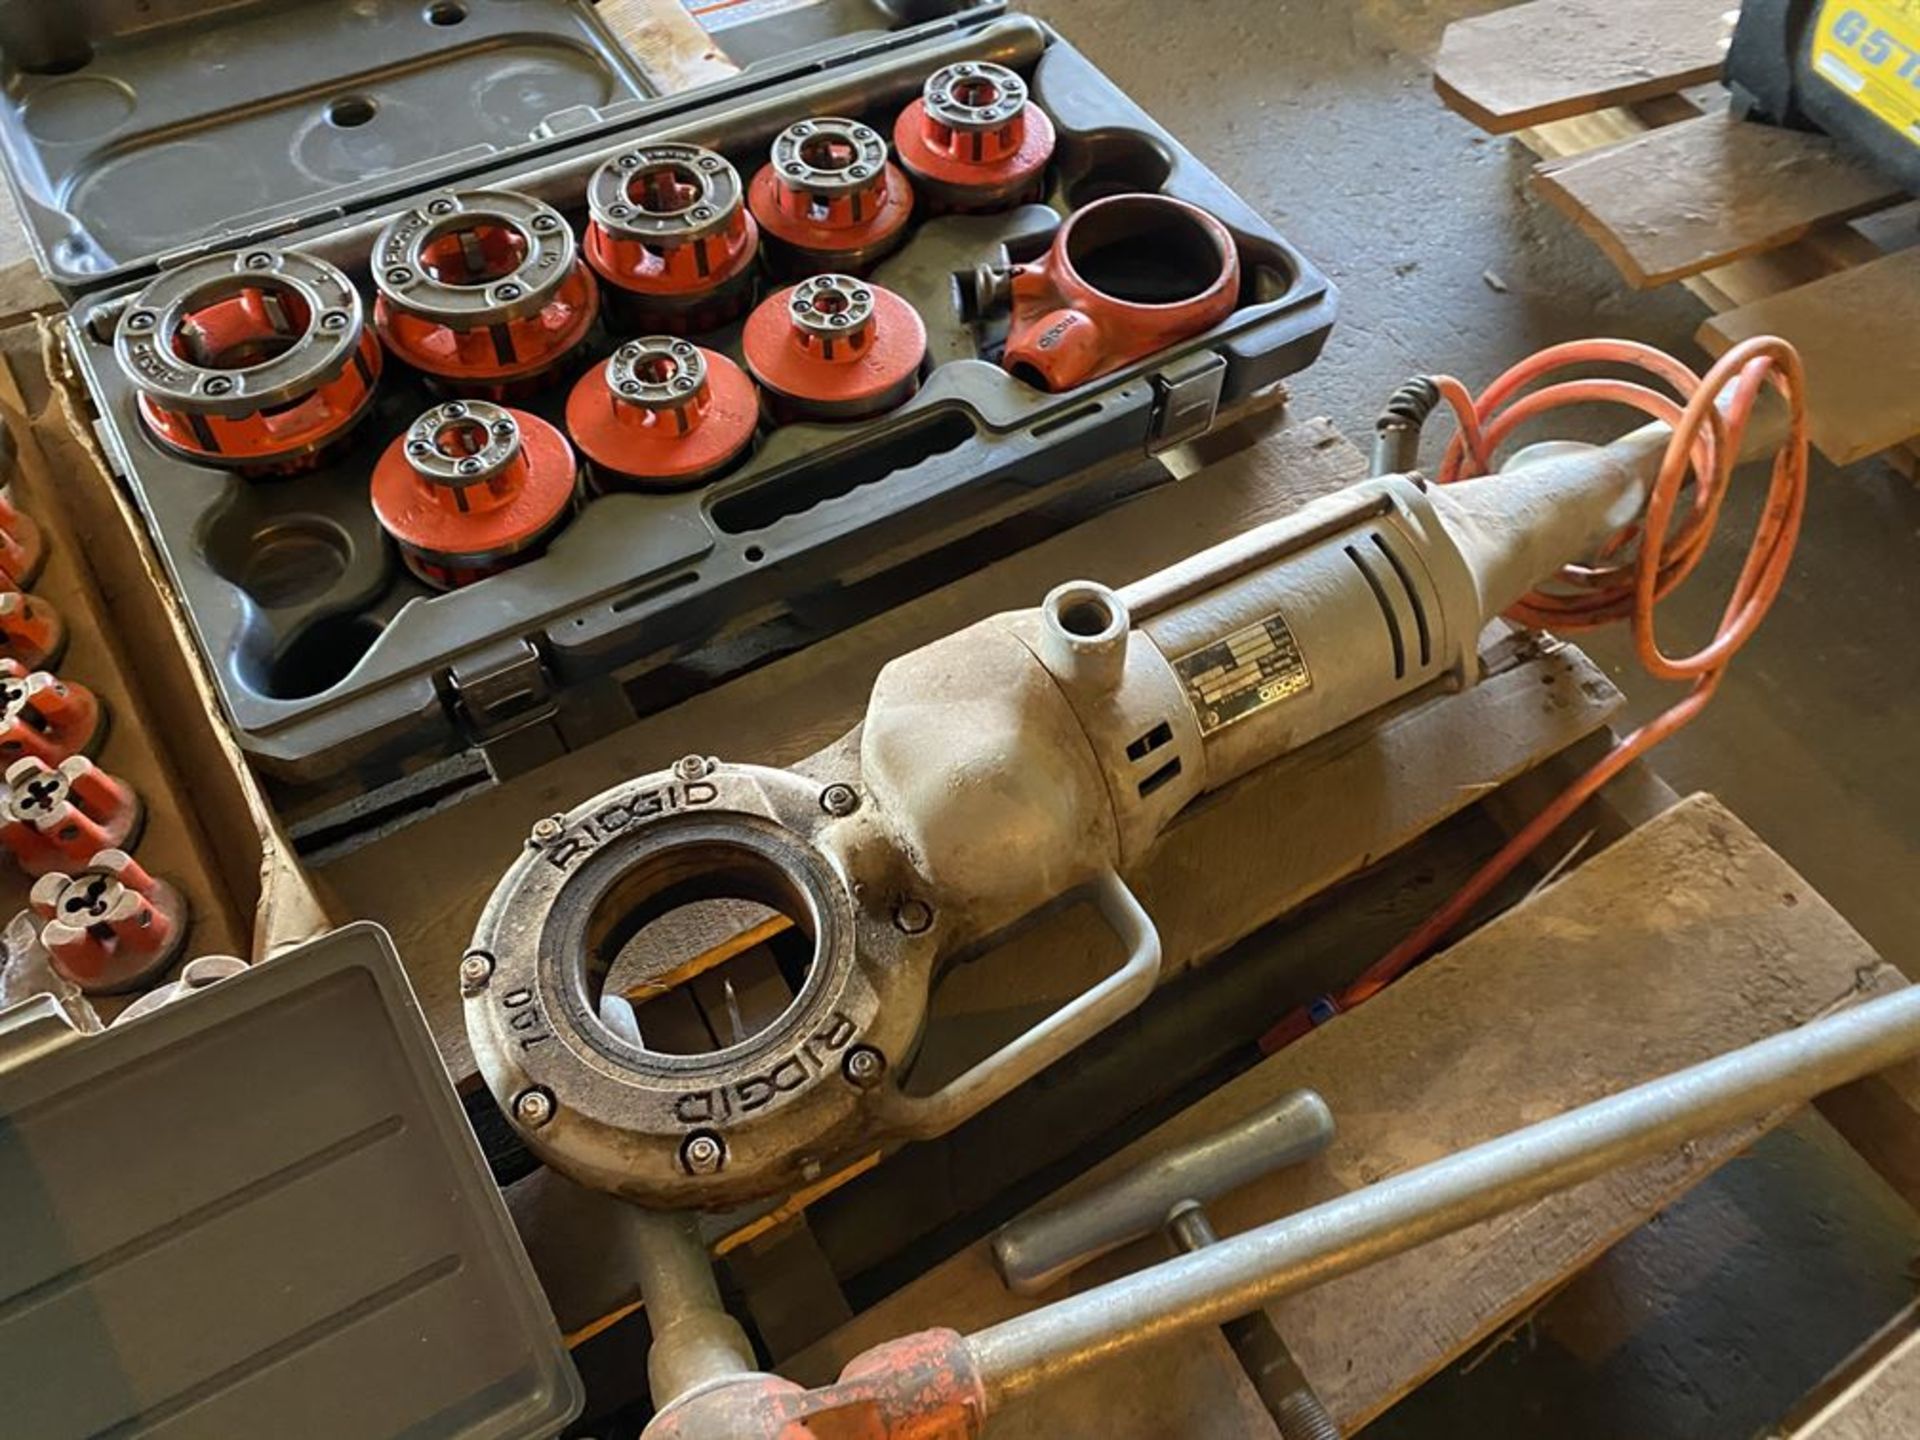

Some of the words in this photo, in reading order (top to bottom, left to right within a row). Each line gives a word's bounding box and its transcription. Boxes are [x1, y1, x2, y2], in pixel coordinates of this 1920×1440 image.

[1832, 9, 1920, 88] G5T
[548, 781, 719, 873] RIDGID
[502, 987, 551, 1053] 700
[673, 1012, 858, 1124] RIDGID
